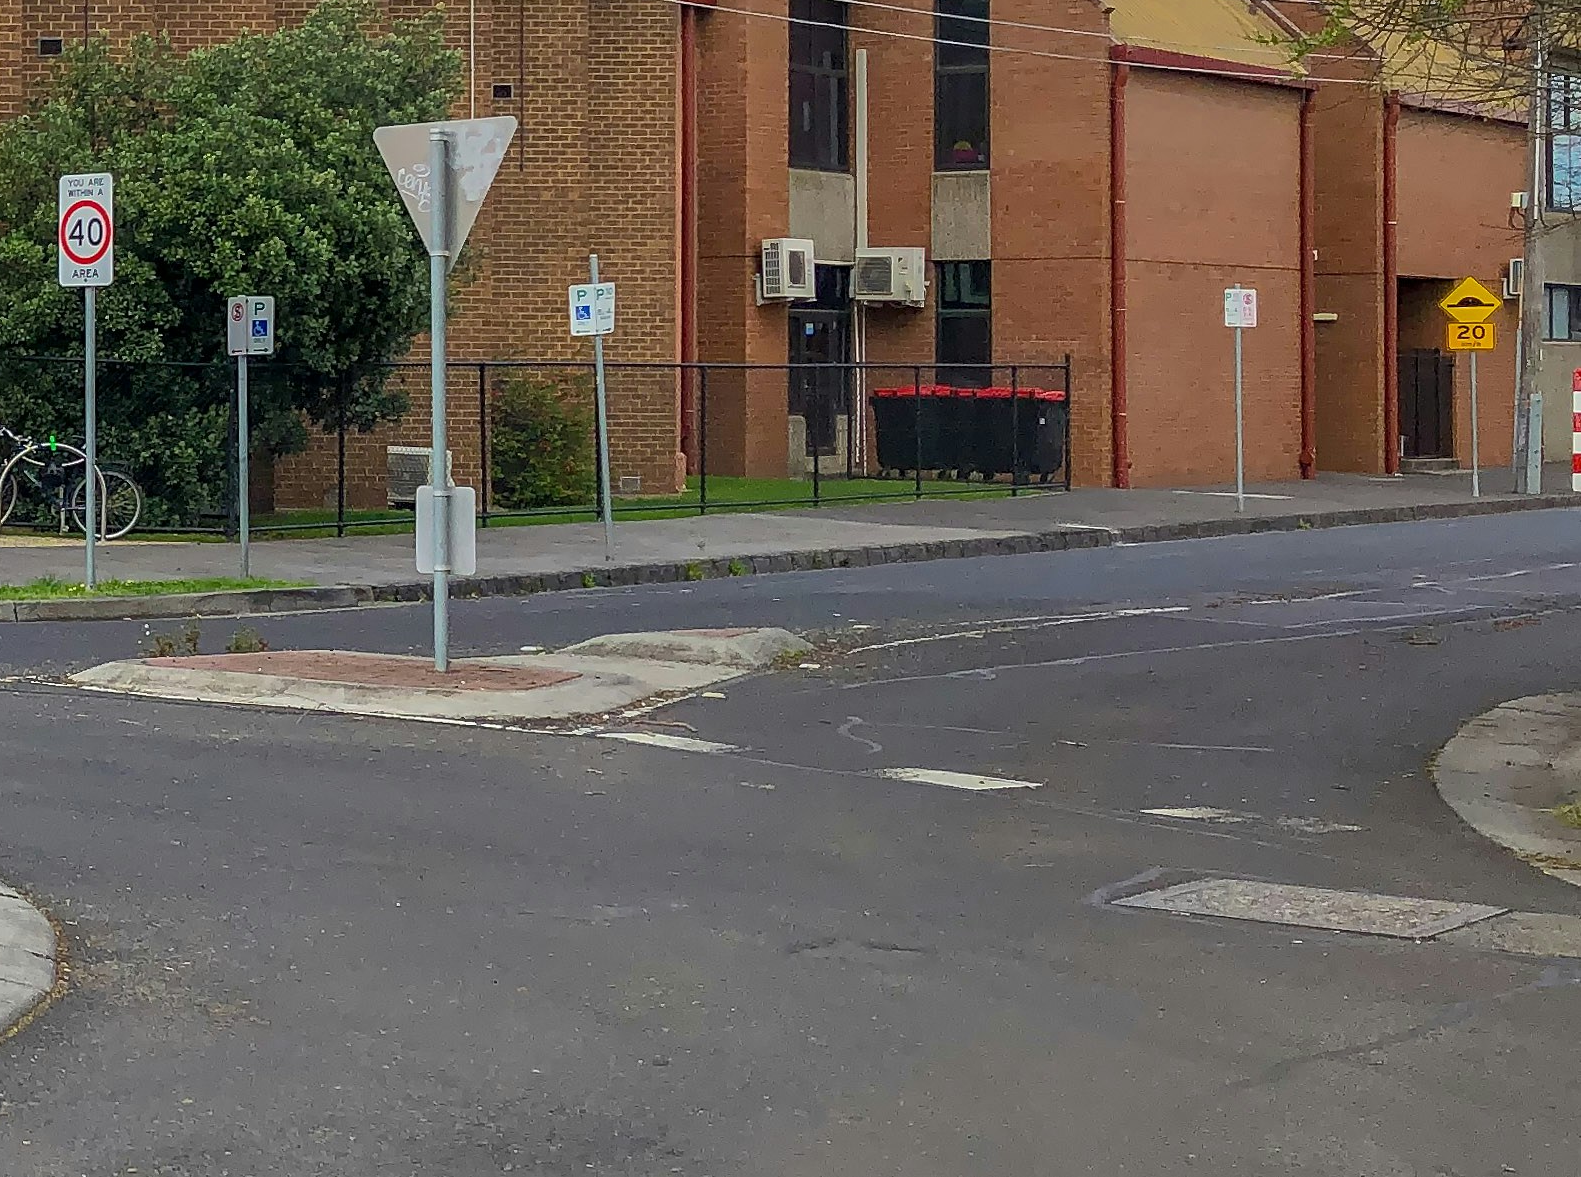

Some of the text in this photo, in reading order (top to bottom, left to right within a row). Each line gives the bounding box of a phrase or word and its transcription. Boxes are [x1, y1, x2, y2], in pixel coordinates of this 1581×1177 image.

[68, 178, 104, 187] YOU ARE
[68, 188, 104, 197] WITHIN A
[68, 217, 103, 246] 40
[71, 268, 99, 279] AREA
[576, 289, 587, 302] P
[596, 288, 605, 301] P
[254, 302, 266, 315] P
[1457, 325, 1486, 340] 20
